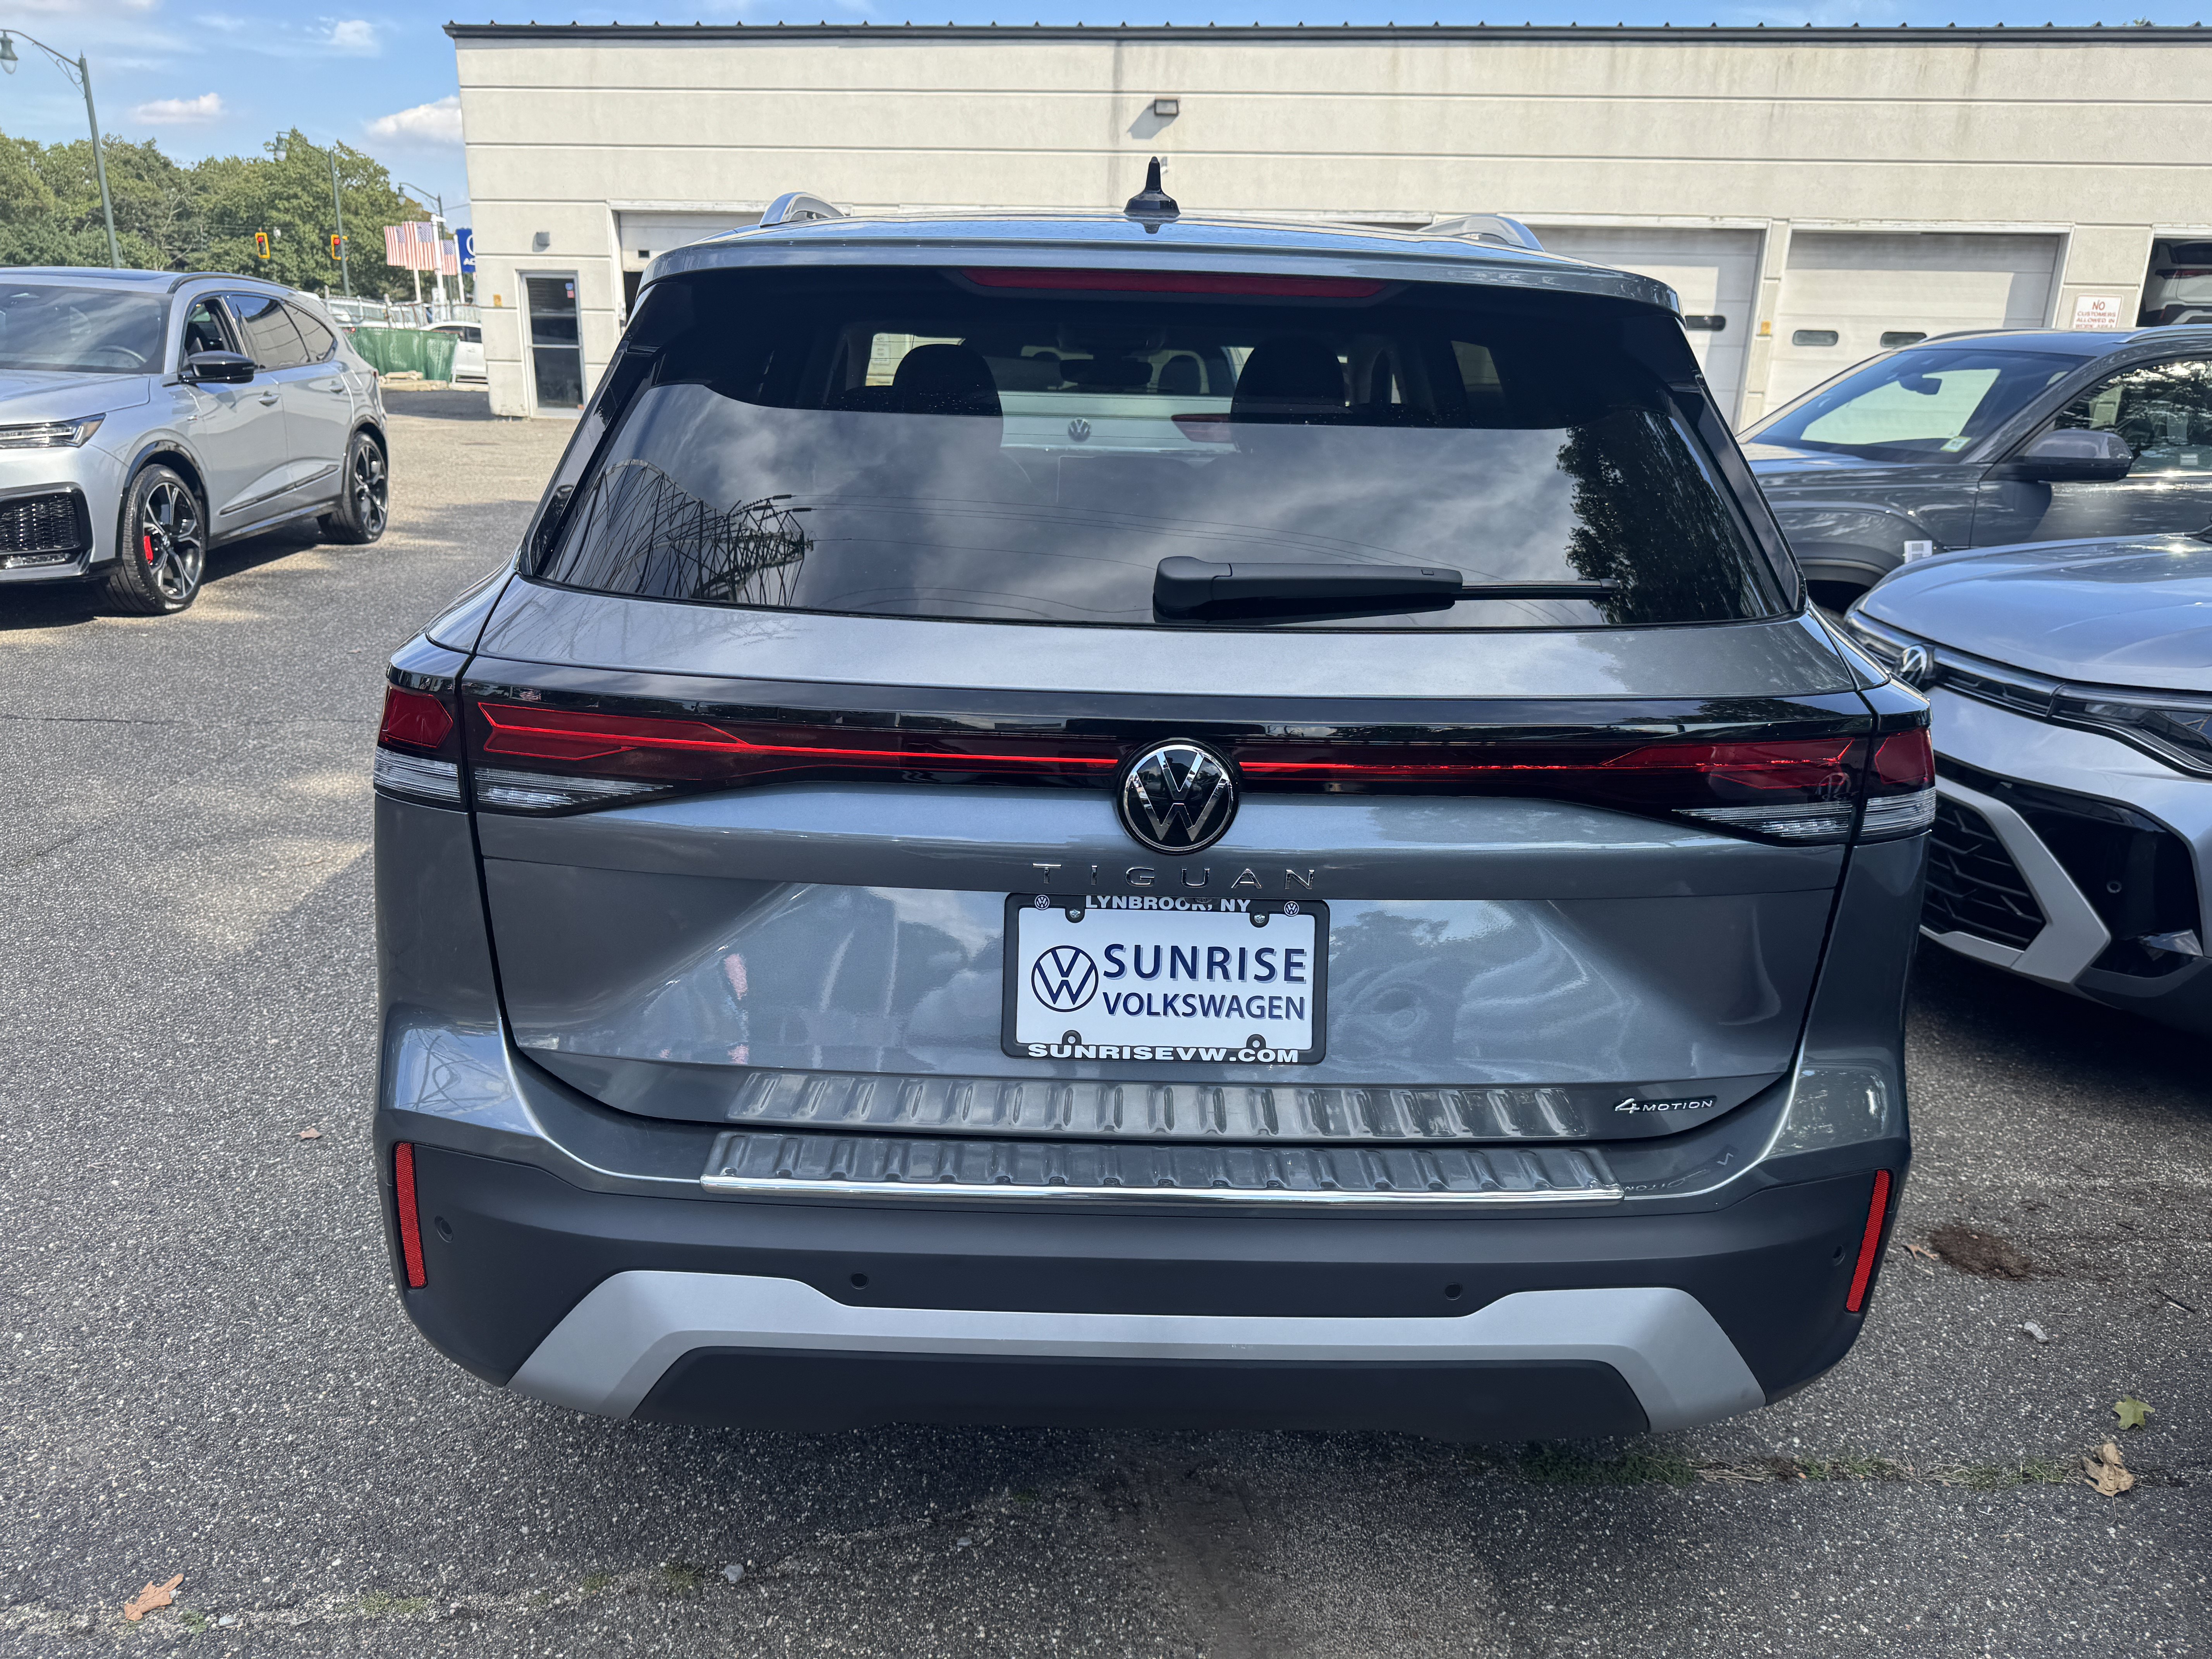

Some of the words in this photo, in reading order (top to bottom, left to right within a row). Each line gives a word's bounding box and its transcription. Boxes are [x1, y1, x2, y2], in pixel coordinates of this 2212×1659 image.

[2092, 300, 2105, 310] NO
[1032, 863, 1316, 890] TIGUAN
[1220, 899, 1251, 912] NY
[1103, 943, 1307, 984] SUNRISE
[1103, 992, 1305, 1020] VOLKSWAGEN
[1028, 1043, 1298, 1063] SUNRISEVW.COM
